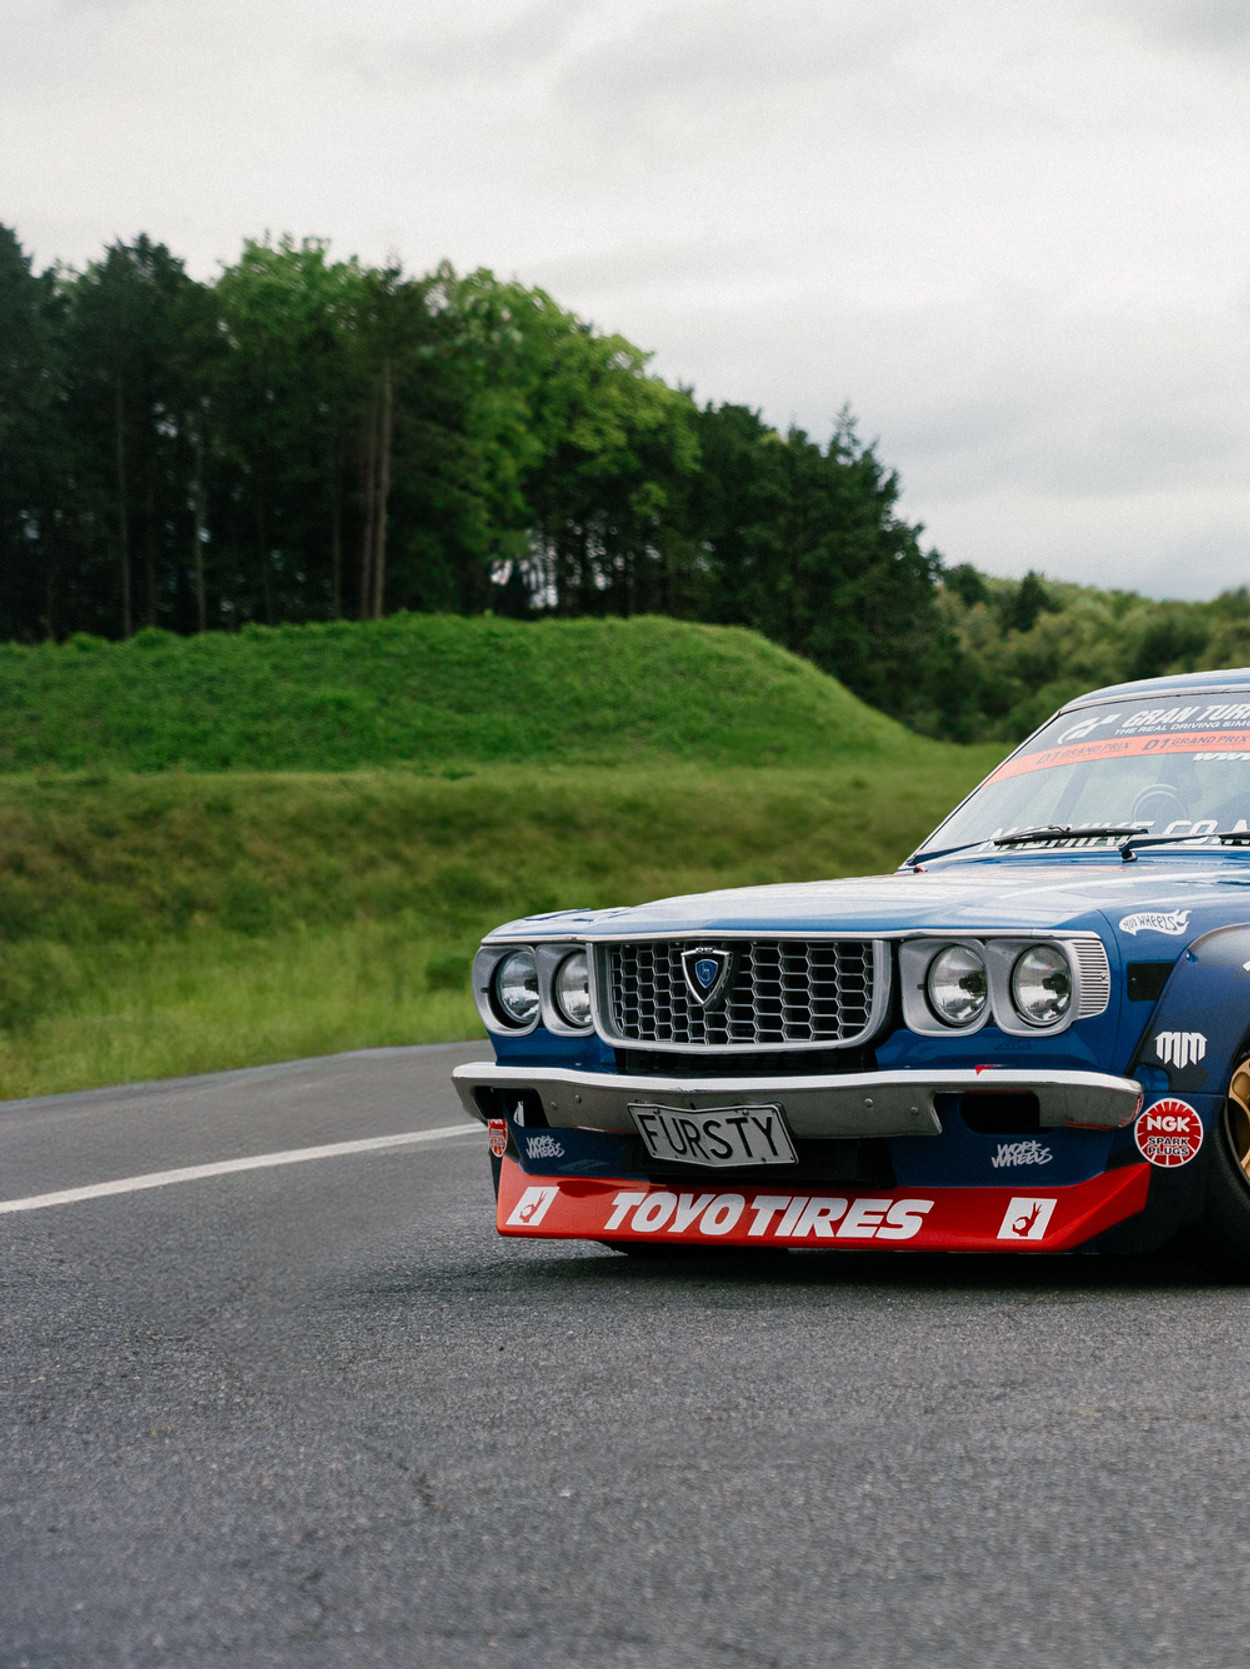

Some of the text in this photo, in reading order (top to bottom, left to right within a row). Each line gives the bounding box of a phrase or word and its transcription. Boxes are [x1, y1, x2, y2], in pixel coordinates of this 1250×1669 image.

[1122, 706, 1201, 728] GRAN
[1115, 728, 1138, 736] THE
[1138, 725, 1168, 733] REAL
[1170, 722, 1221, 730] DRIVING
[1143, 735, 1249, 751] D1 GRAND PRIX
[1146, 1115, 1191, 1133] NGK
[637, 1113, 779, 1161] FURSTY
[1147, 1135, 1190, 1146] SPARK
[1147, 1146, 1190, 1157] PLUGS
[603, 1192, 935, 1240] TOYO TIRES
